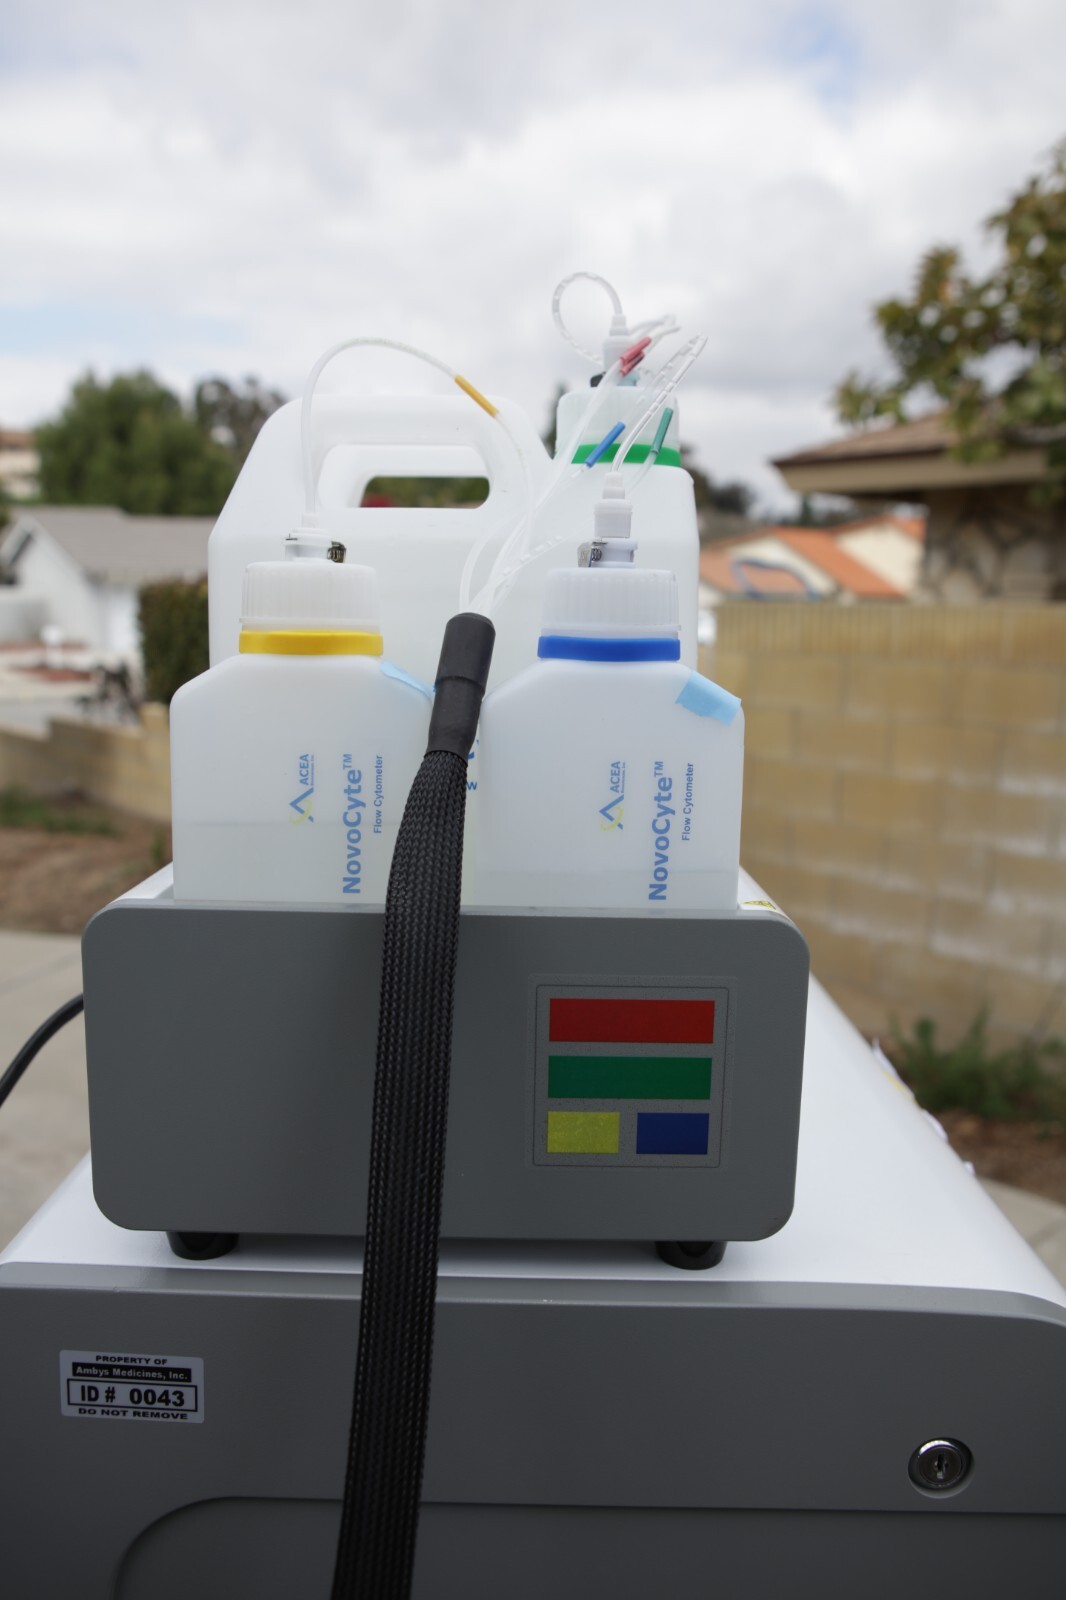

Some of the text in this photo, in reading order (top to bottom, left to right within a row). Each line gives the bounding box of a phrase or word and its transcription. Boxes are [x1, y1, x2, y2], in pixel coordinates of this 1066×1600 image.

[299, 753, 309, 786] ACEA
[609, 761, 621, 793] ACEA
[373, 755, 385, 834] Flow Cytometer
[681, 762, 694, 841] Flow Cytometer
[76, 1366, 188, 1380] Ambys Medicines, Inc.
[95, 1355, 168, 1366] PROPERTY OF
[80, 1385, 185, 1407] ID # 0043
[78, 1407, 188, 1420] DO NOT REMOVE
